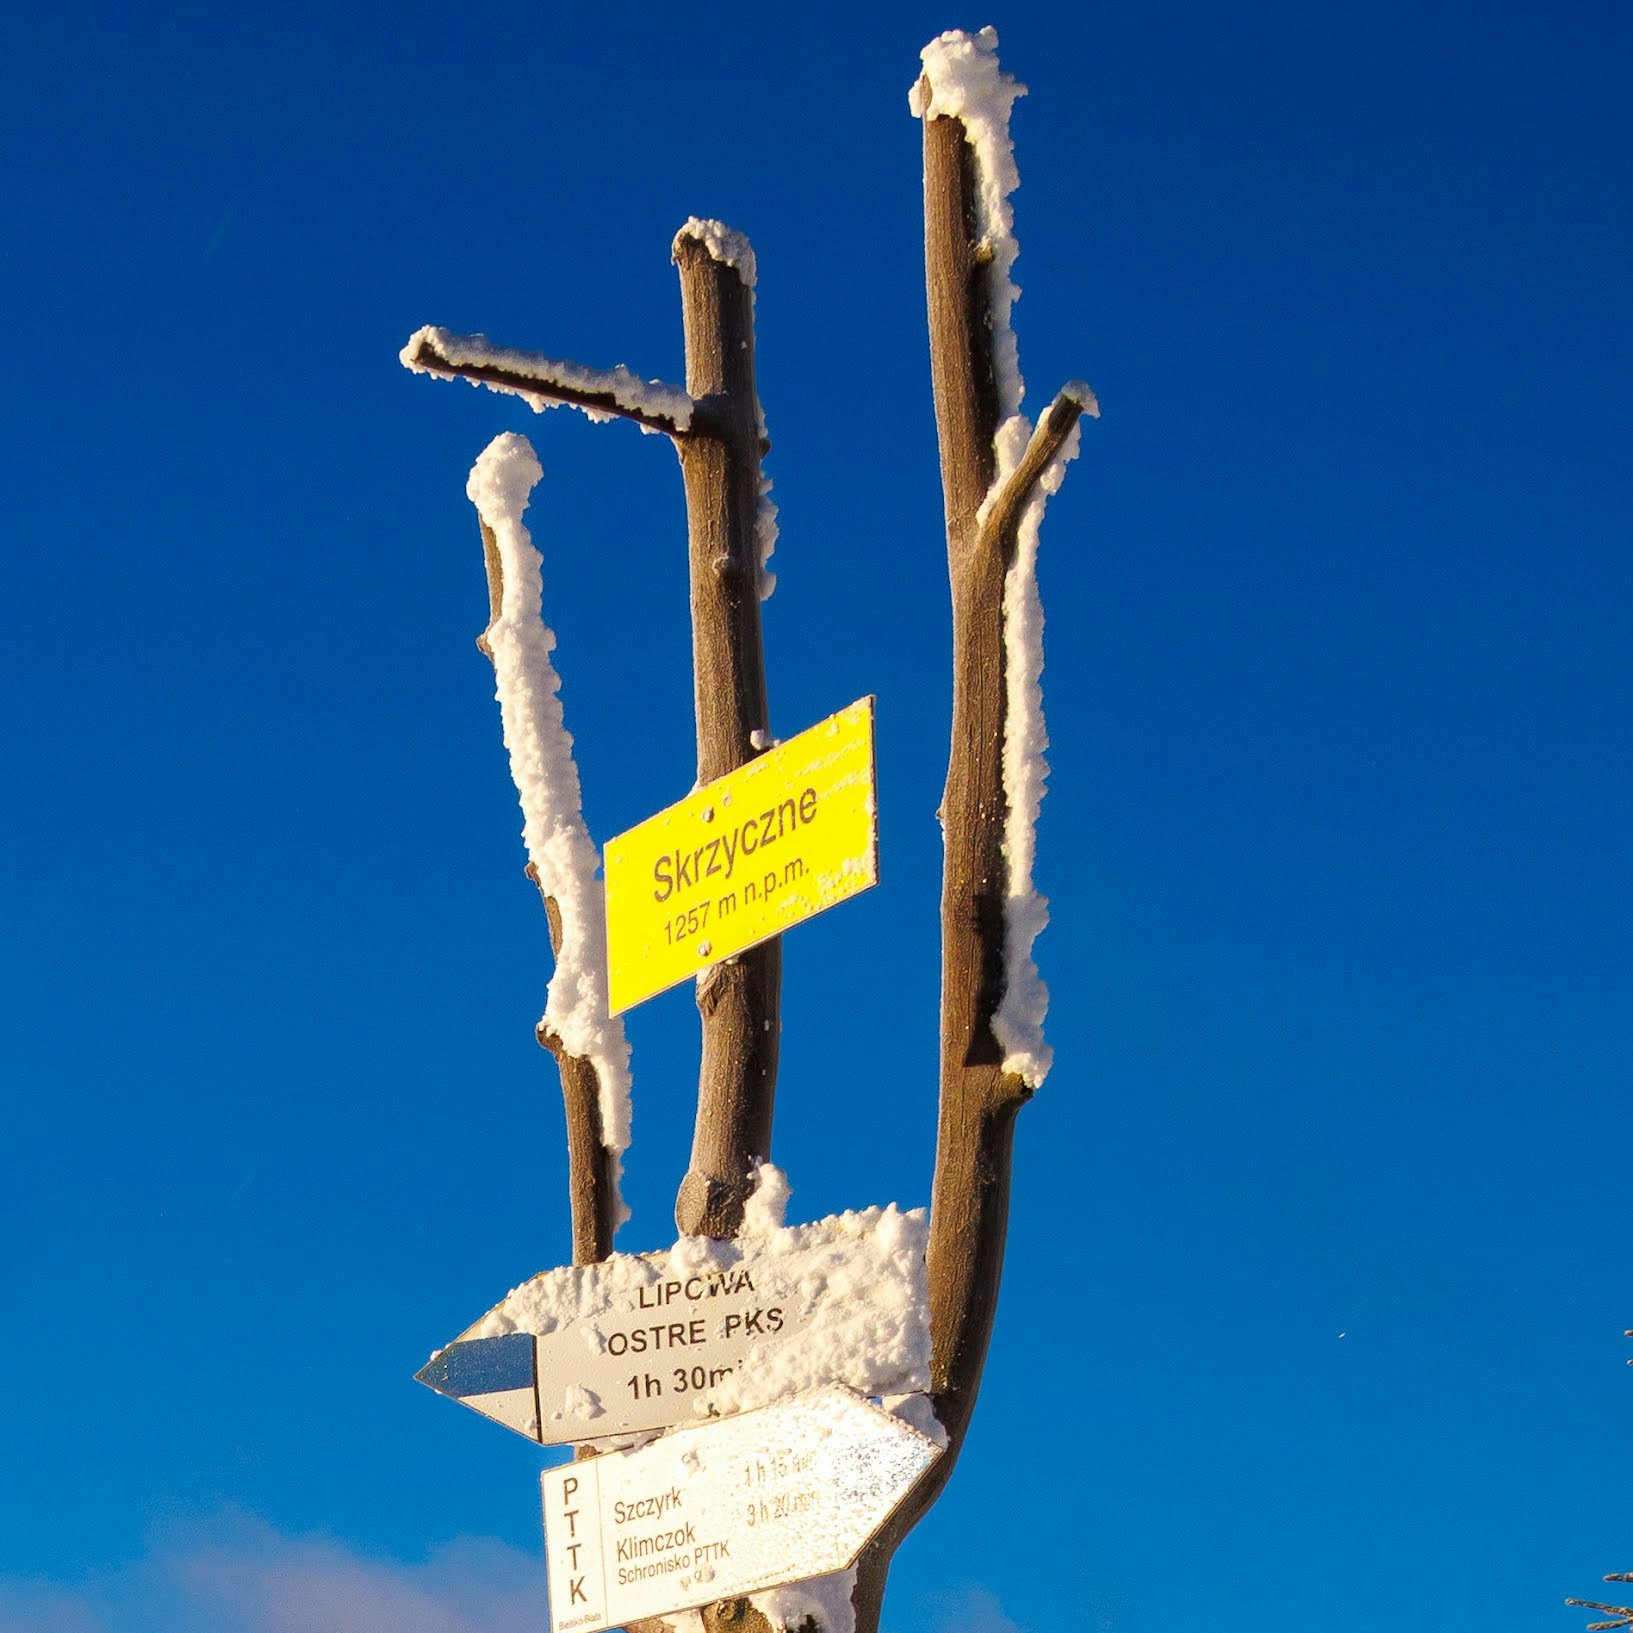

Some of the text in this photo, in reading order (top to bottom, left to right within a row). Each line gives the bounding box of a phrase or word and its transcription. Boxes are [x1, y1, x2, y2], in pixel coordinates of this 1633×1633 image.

[654, 787, 818, 903] Skrzyczne
[664, 857, 810, 945] 1257 m n.p.m.
[639, 1270, 755, 1309] LIPOWA
[608, 1307, 784, 1356] OSTRE PKS
[627, 1359, 743, 1400] 1h 30m
[613, 1486, 683, 1525] Szczyrk
[616, 1522, 695, 1563] Klimczok
[747, 1504, 756, 1527] 3
[760, 1500, 769, 1522] h
[618, 1540, 731, 1586] Schronisko PTTK
